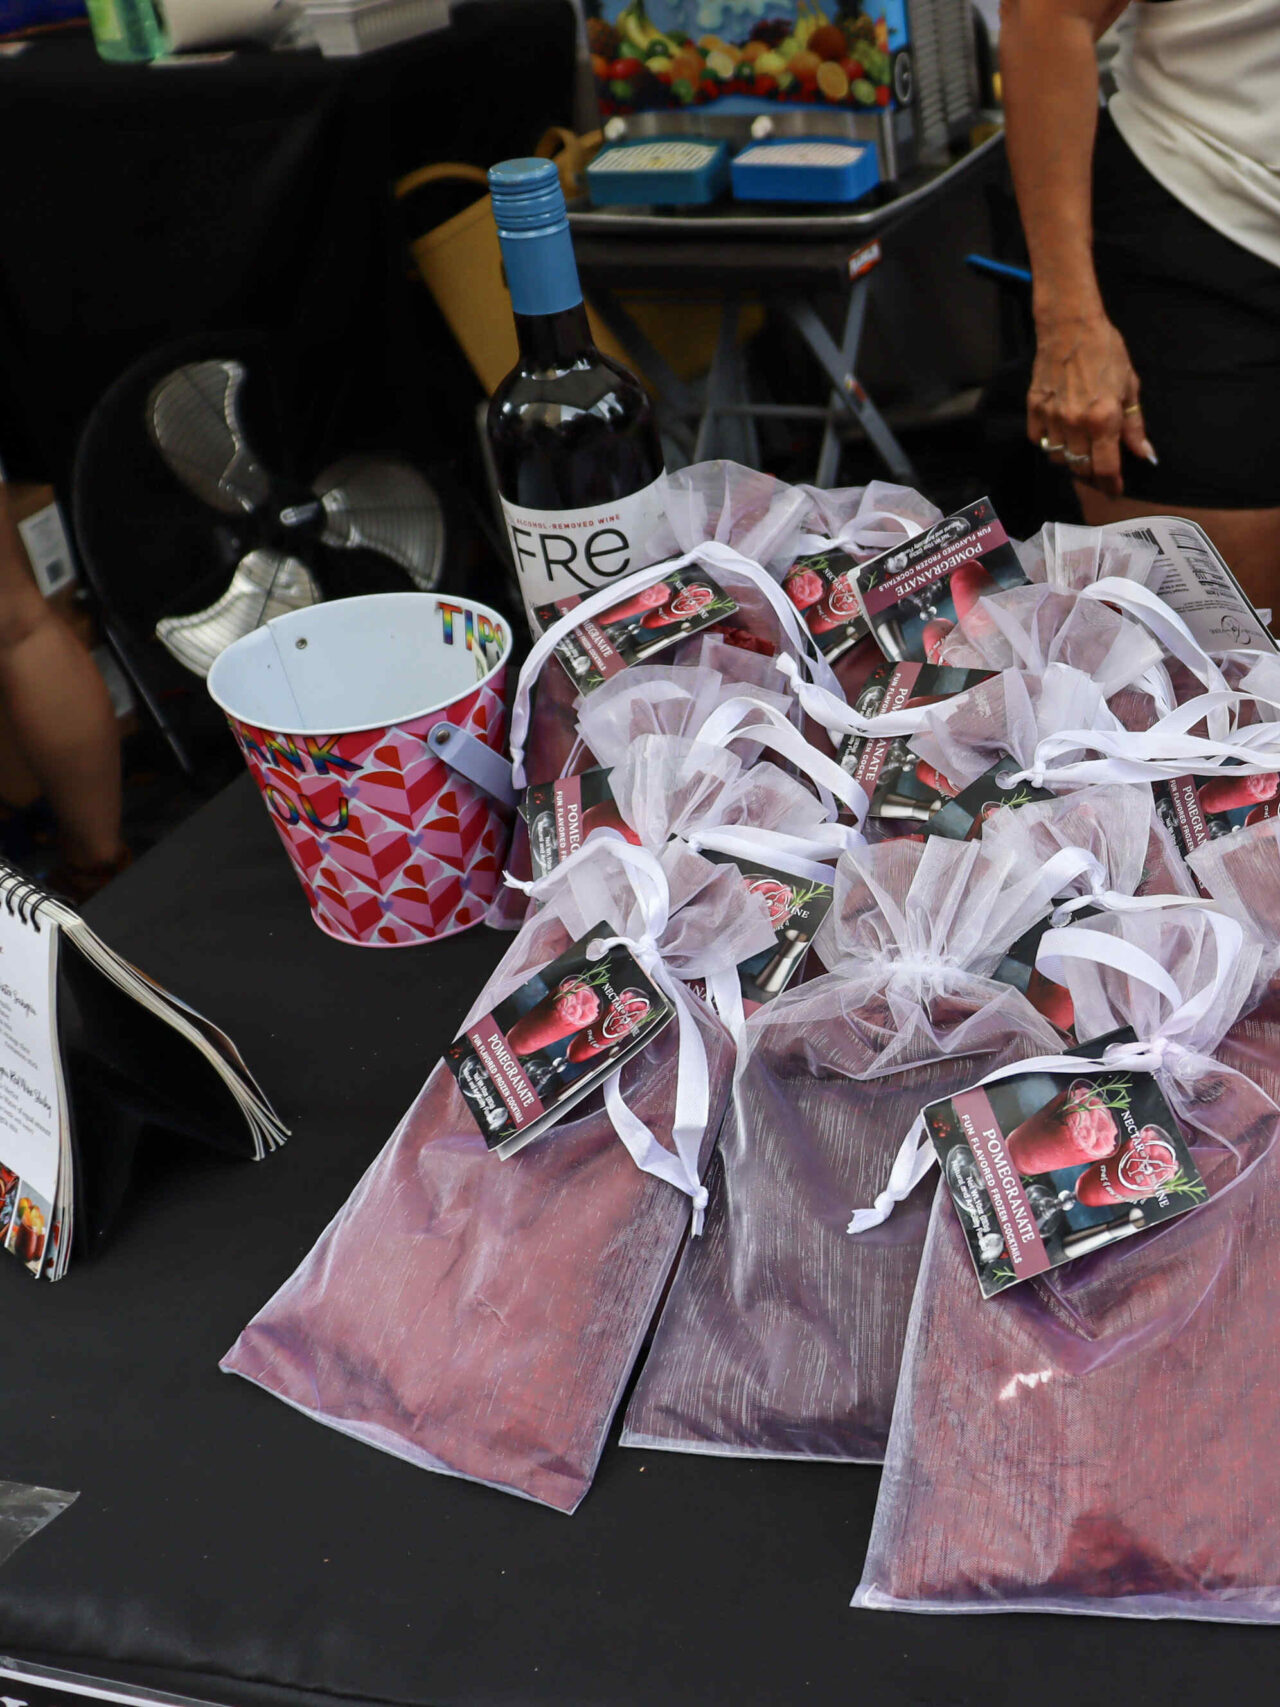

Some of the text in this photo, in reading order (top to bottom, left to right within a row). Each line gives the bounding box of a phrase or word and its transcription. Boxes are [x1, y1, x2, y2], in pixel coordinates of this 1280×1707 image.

[597, 513, 621, 524] WINE
[822, 567, 843, 590] NECTAR
[876, 525, 992, 592] FUN FLAVORED FROZEN COCKTAILS
[893, 541, 984, 597] POMEGRANATE
[889, 672, 901, 688] FUN
[241, 721, 364, 776] ANK
[265, 783, 350, 833] OU
[555, 790, 567, 848] FUN FLAVORED
[1168, 779, 1195, 851] FUN FLAVORED FROZEN
[784, 903, 809, 919] VINE
[600, 982, 626, 1011] NECTAR
[470, 1033, 483, 1047] FUN
[477, 1044, 498, 1074] FLAVORED
[492, 1072, 510, 1097] FROZEN
[486, 1032, 535, 1107] POMEGRANATE
[1118, 1109, 1146, 1152] NECTAR
[959, 1185, 969, 1199] and
[961, 1113, 1024, 1263] FUN FLAVORED FROZEN COCKTAILS
[965, 1176, 975, 1188] Net
[980, 1127, 1036, 1243] POMEGRANATE
